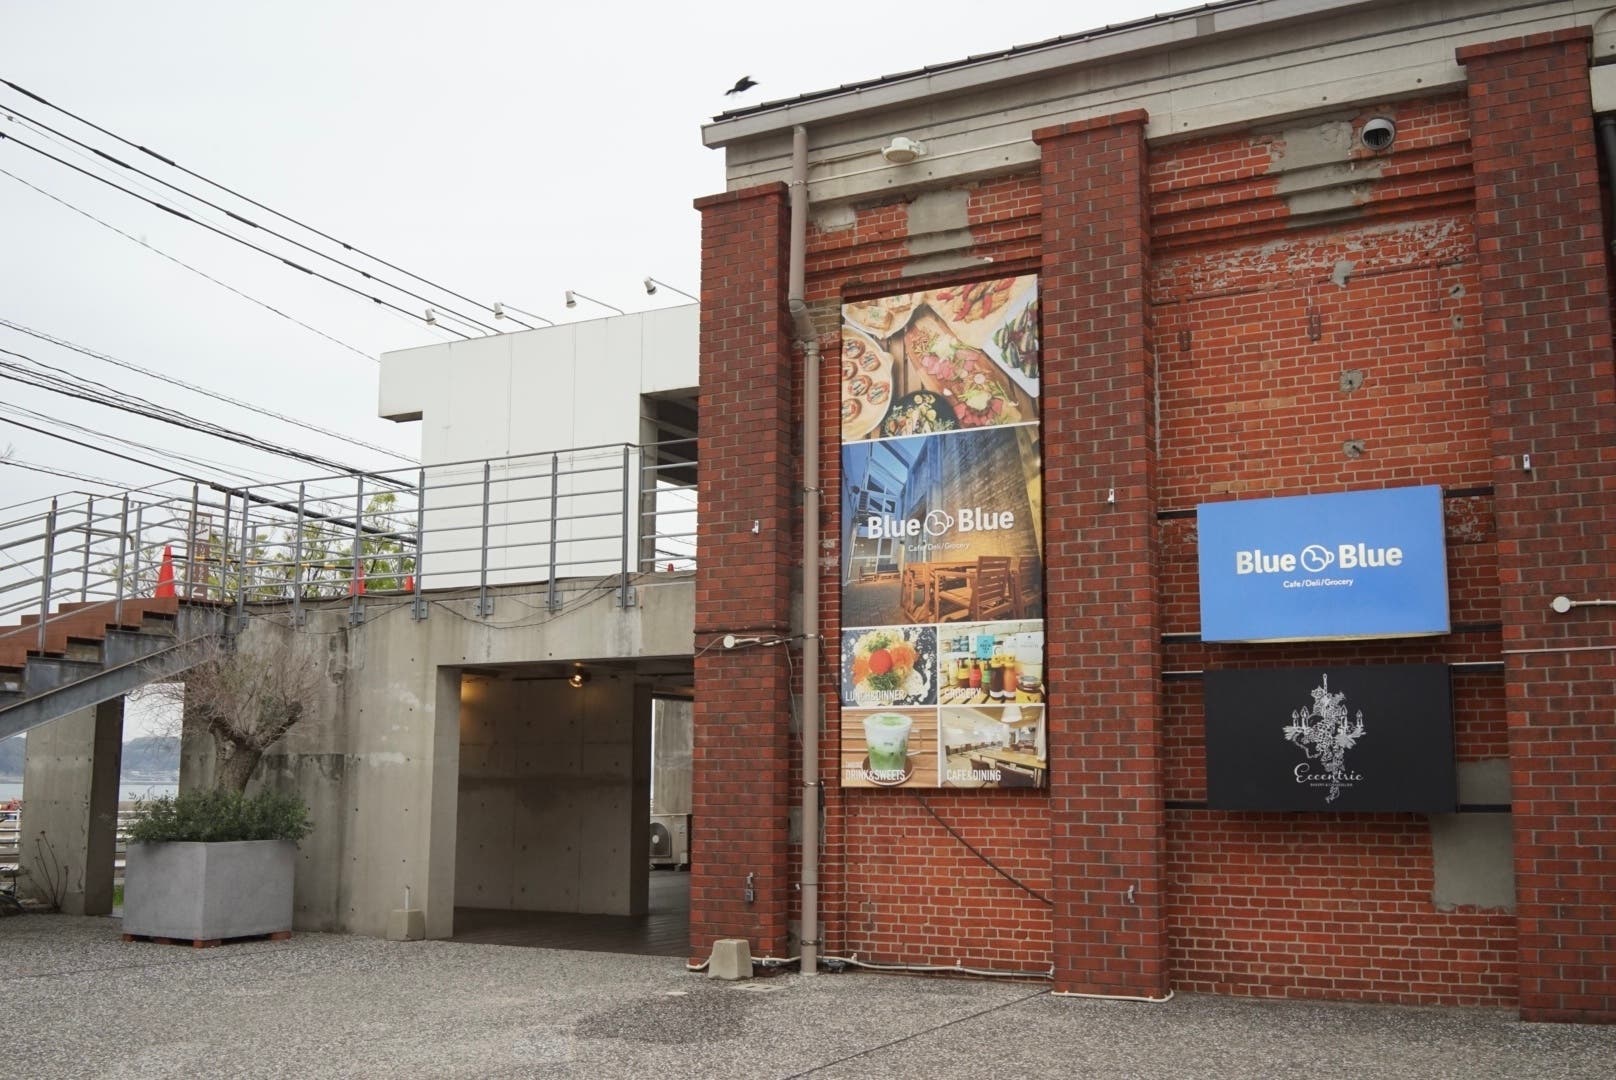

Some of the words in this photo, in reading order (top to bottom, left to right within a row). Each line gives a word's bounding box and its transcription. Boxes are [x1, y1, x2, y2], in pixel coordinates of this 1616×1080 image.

[868, 514, 921, 539] Blue
[958, 507, 1014, 532] Blue
[1236, 549, 1296, 575] Blue
[1338, 542, 1403, 569] Blue
[845, 769, 906, 782] DRINK&SWEETS
[946, 769, 1002, 782] CAFE&DINING
